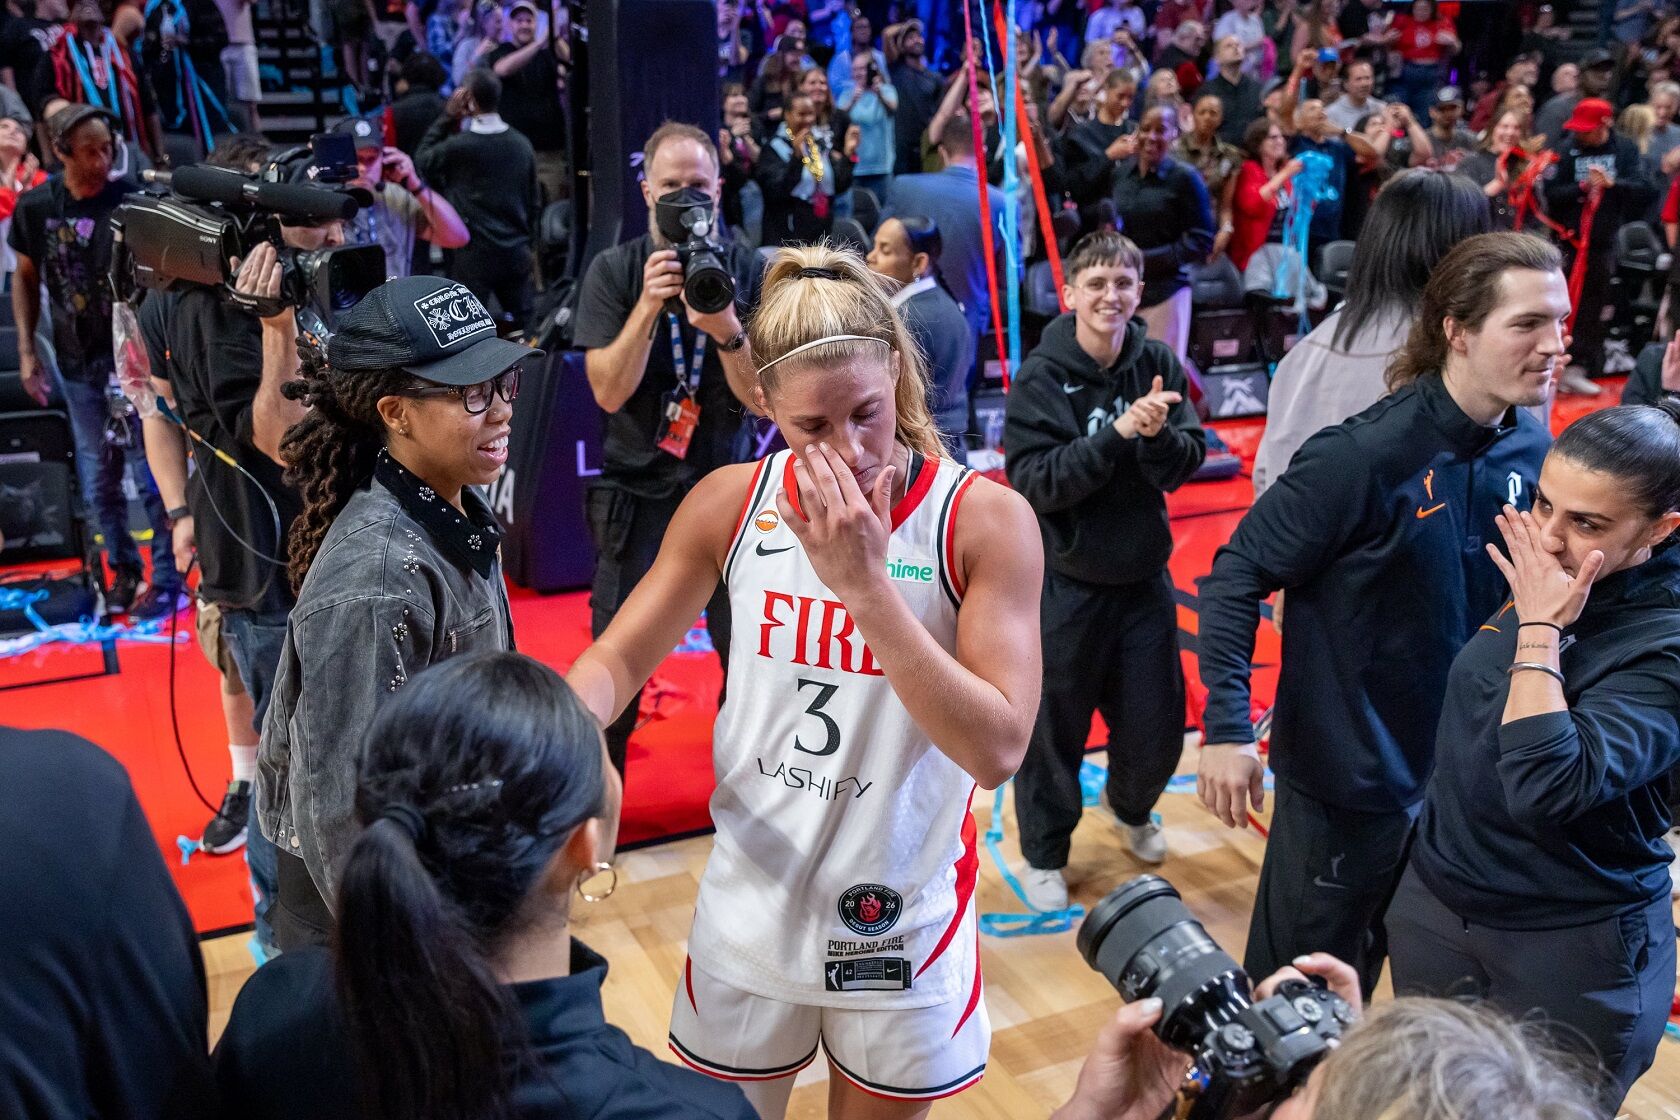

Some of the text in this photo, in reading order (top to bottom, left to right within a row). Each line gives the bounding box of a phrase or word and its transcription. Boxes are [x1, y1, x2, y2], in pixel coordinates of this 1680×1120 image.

[886, 558, 933, 582] hime
[794, 678, 841, 756] 3
[757, 757, 873, 800] LASHIFY
[845, 900, 896, 909] 20 26
[849, 918, 890, 932] DEBUT SEASON
[828, 935, 904, 951] PORTLAND FIRE
[876, 943, 904, 953] EDITION
